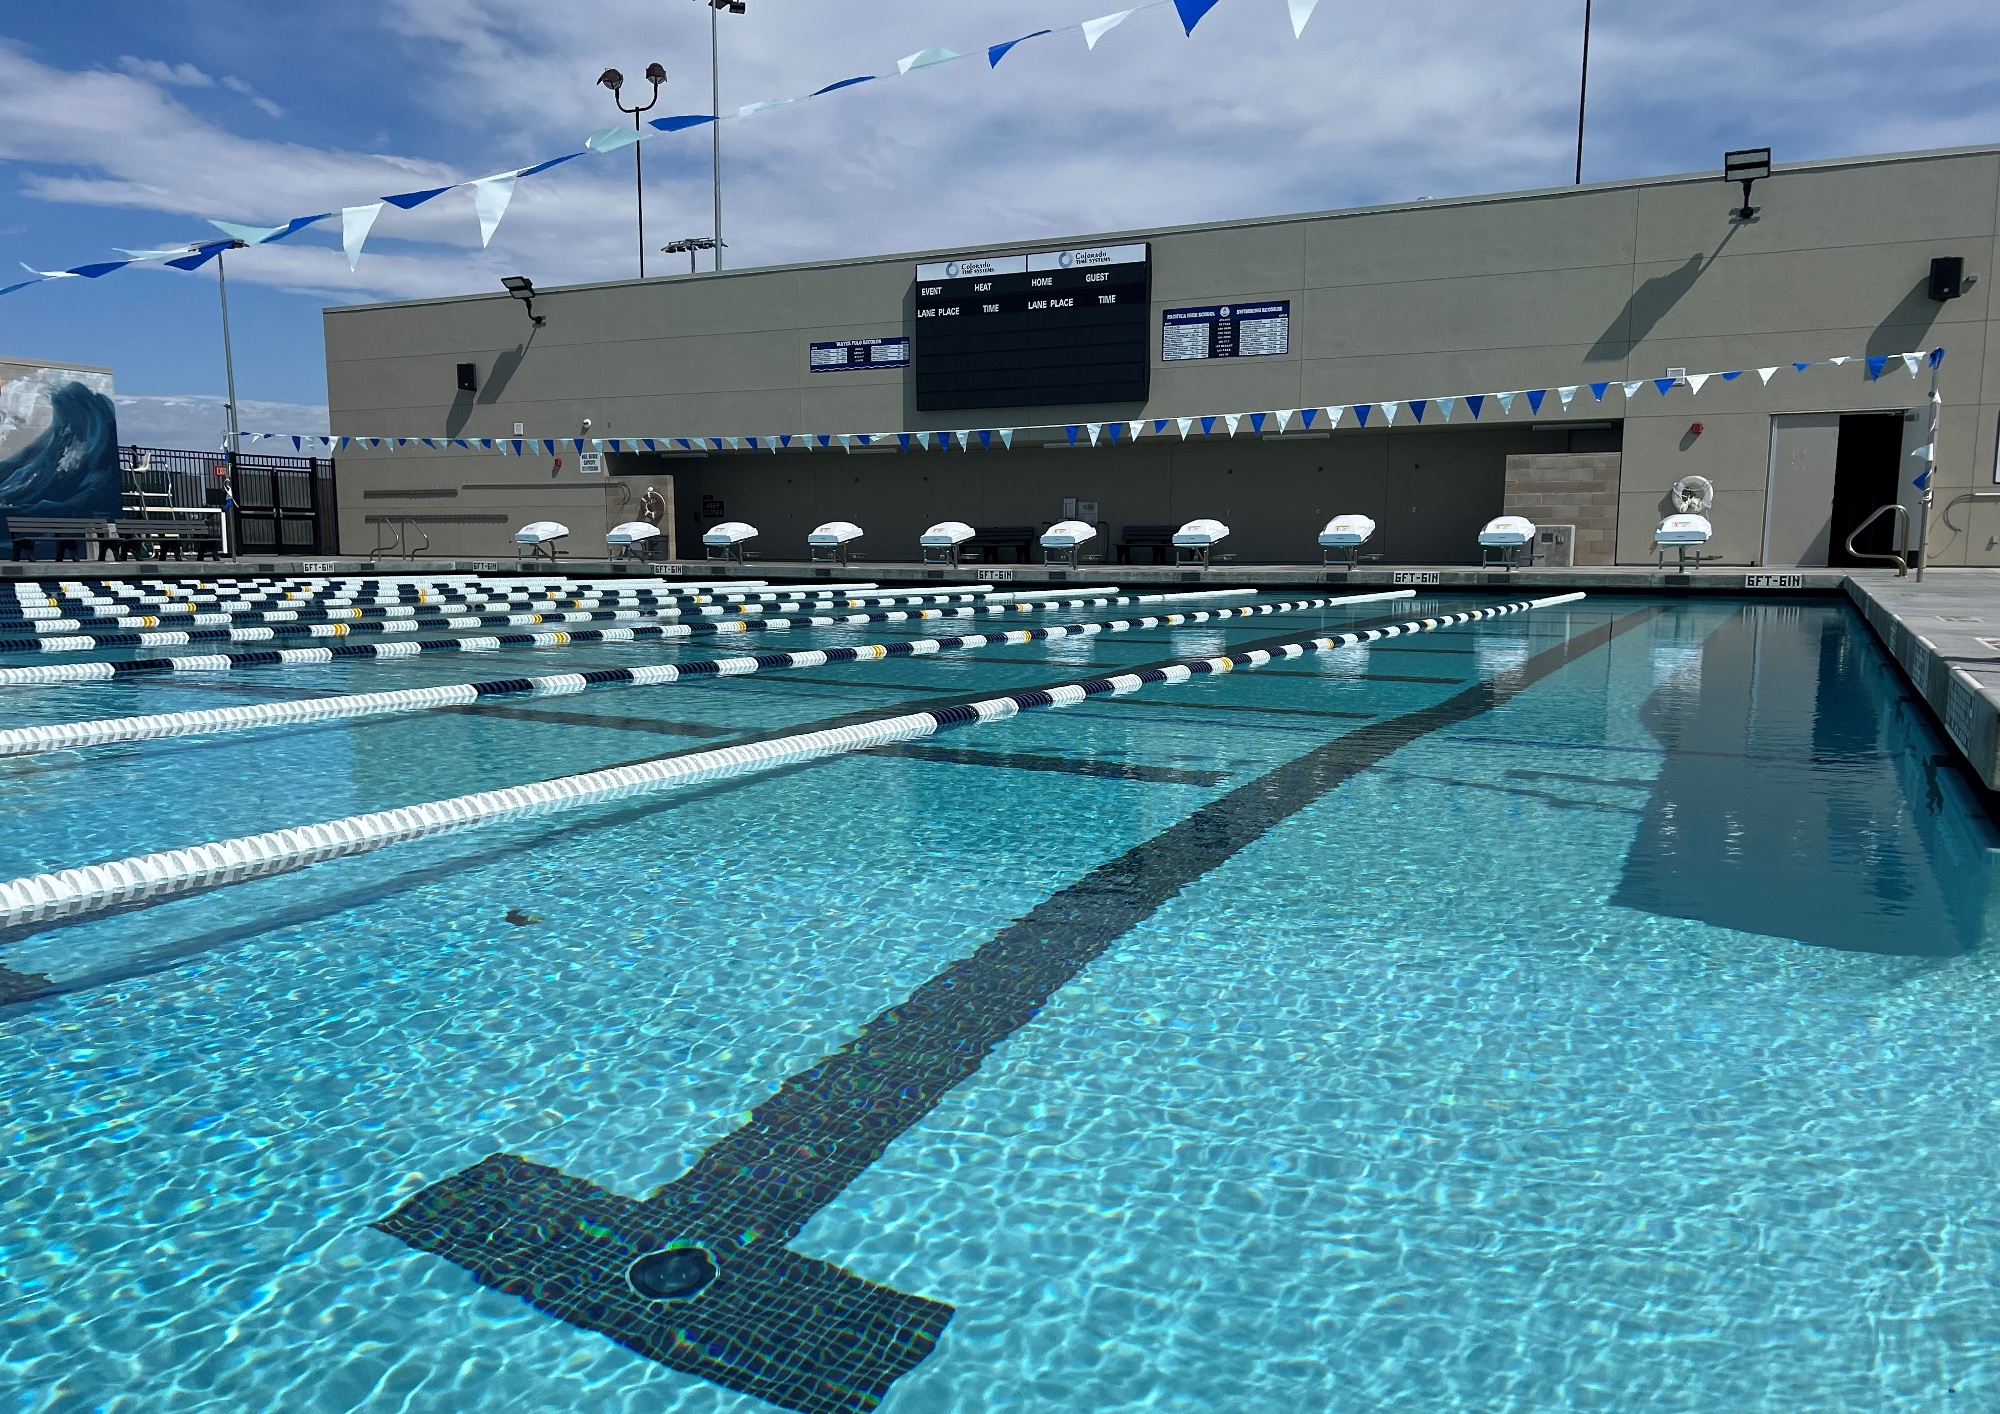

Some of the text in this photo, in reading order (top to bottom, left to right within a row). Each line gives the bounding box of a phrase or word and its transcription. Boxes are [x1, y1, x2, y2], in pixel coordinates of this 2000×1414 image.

[921, 272, 1109, 296] EVENT HEAT HOME GUEST
[1027, 294, 1116, 310] LANE PLACE TIME
[917, 304, 999, 318] LANE PLACE TIME
[304, 563, 334, 572] 6FT-6IN
[979, 570, 1012, 580] 6FT-6IN
[1394, 573, 1439, 583] 6FT-6IN
[1747, 575, 1800, 587] 6FT-6IN
